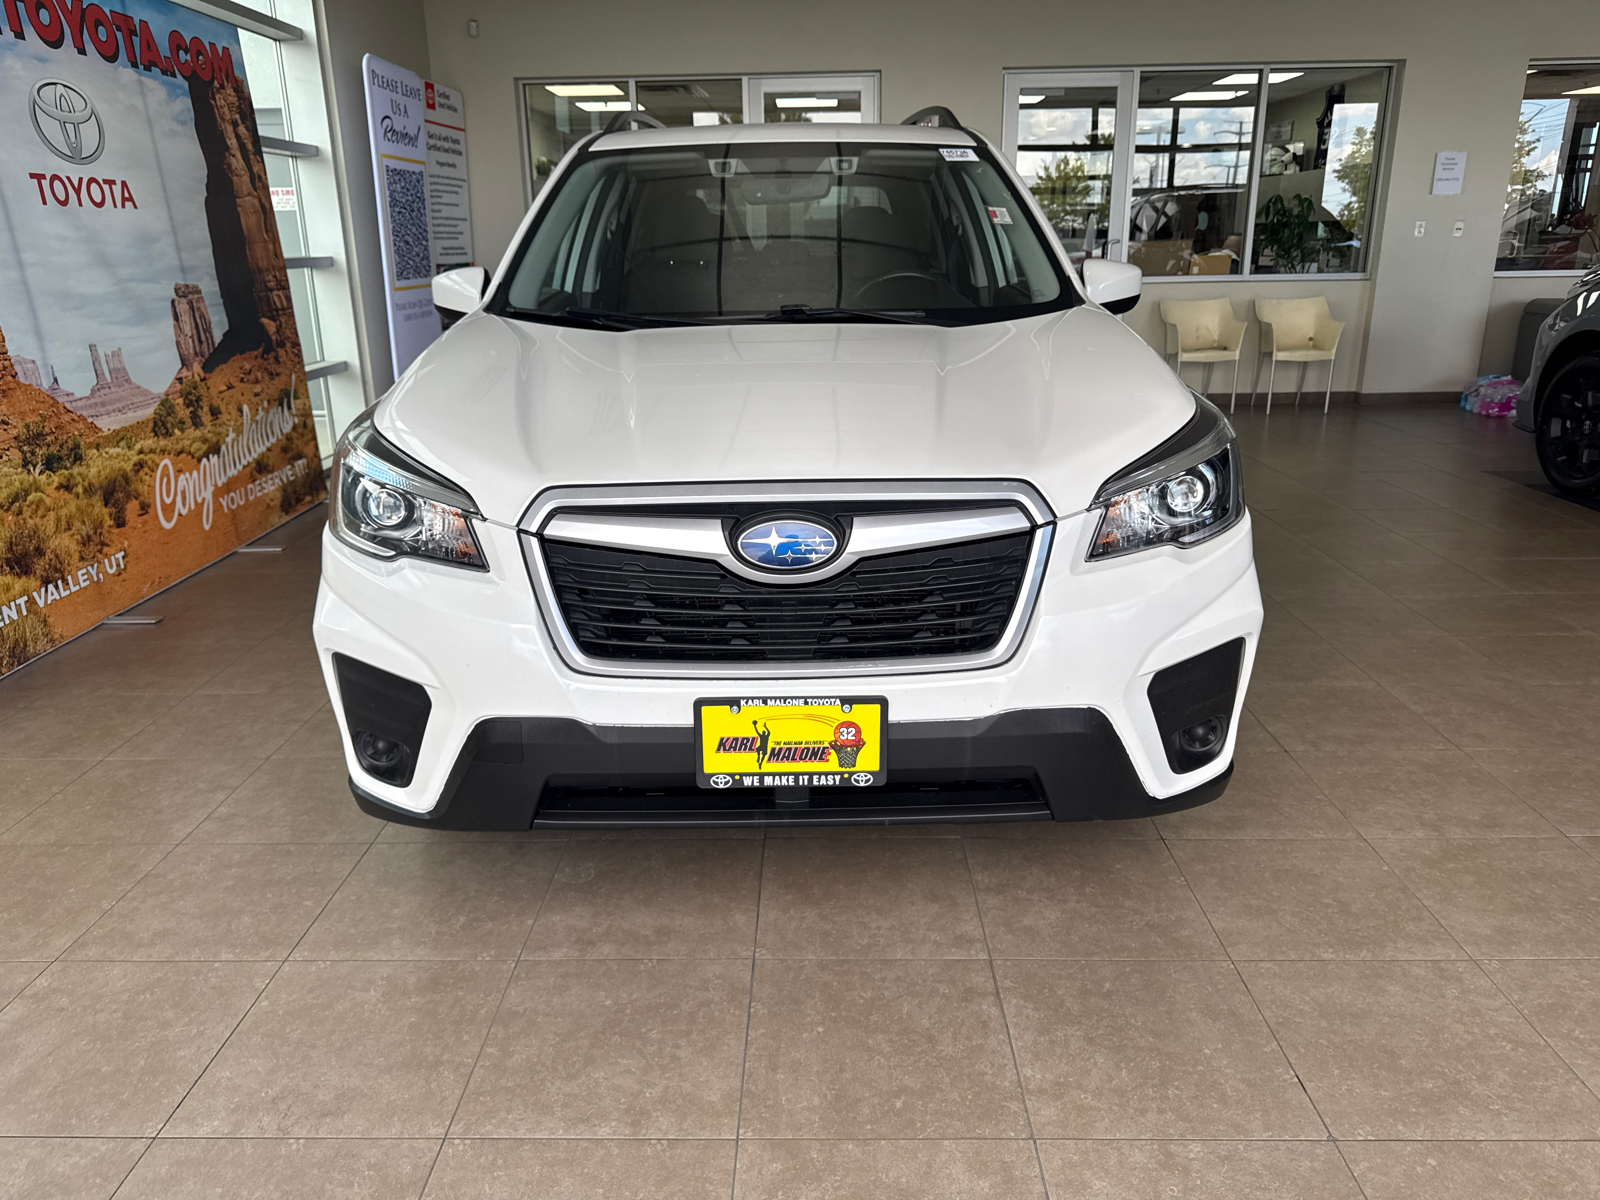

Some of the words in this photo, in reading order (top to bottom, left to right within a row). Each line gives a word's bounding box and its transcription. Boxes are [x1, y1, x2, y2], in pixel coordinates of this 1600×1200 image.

[371, 69, 399, 95] PLEASE
[400, 81, 422, 102] LEAVE
[403, 103, 410, 120] A
[381, 115, 421, 149] Review!
[29, 172, 138, 210] TOYOTA
[155, 372, 298, 530] Congratulations!
[219, 487, 246, 513] YOU
[247, 464, 295, 501] DESERVE
[32, 562, 104, 608] VALLEY,
[104, 551, 125, 574] UT
[740, 699, 765, 707] KARL
[807, 698, 841, 706] TOYOTA
[715, 736, 759, 754] KARL
[839, 727, 856, 740] 32
[766, 746, 832, 763] MALONE
[743, 776, 760, 787] WE
[763, 775, 795, 786] MAKE
[798, 775, 809, 786] IT
[812, 775, 841, 786] EASY
